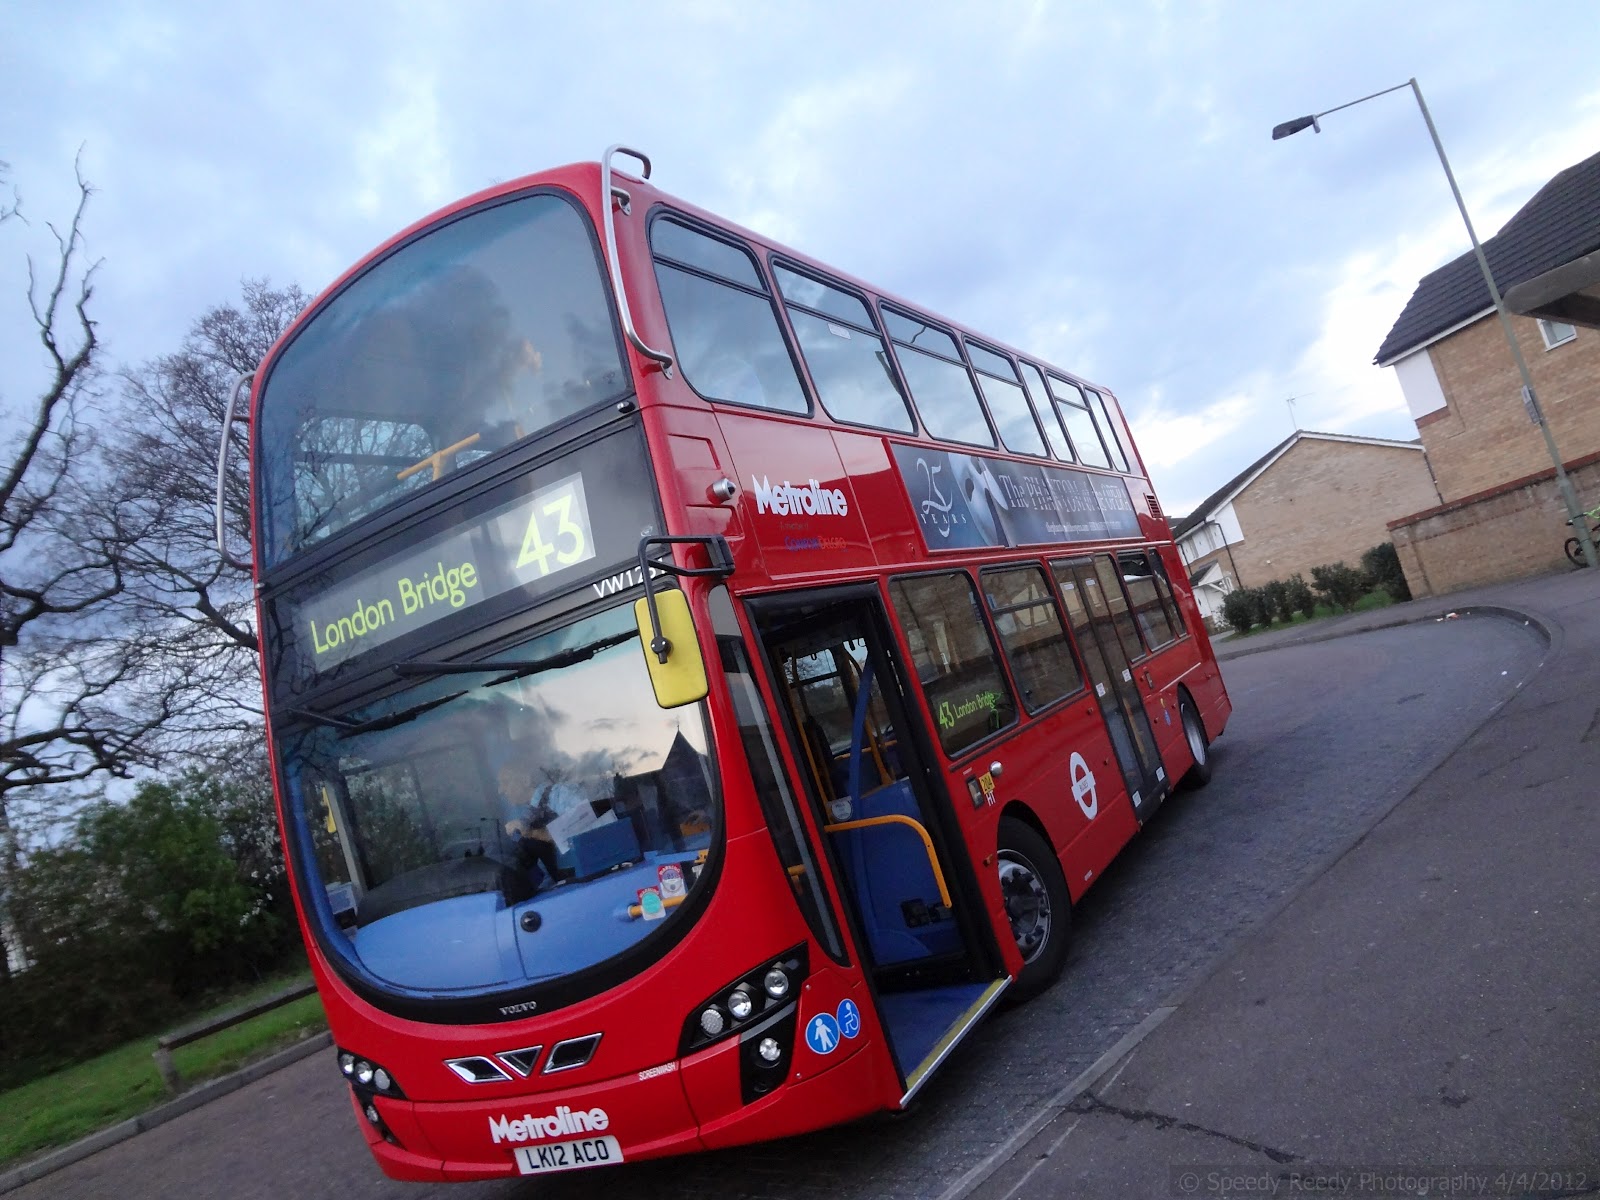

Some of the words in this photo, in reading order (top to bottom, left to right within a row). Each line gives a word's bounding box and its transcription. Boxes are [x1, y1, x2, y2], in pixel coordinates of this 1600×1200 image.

[752, 473, 848, 517] Metroline
[920, 513, 967, 524] YEARS
[515, 494, 585, 576] 43
[310, 599, 395, 654] London
[398, 561, 478, 616] Bridge
[939, 701, 955, 729] 43
[953, 698, 979, 719] London
[499, 1001, 538, 1016] VOLVO
[638, 1061, 676, 1081] SCREENWASH
[488, 1105, 610, 1144] Metroline
[526, 1145, 569, 1169] LK12
[573, 1139, 610, 1165] ACO
